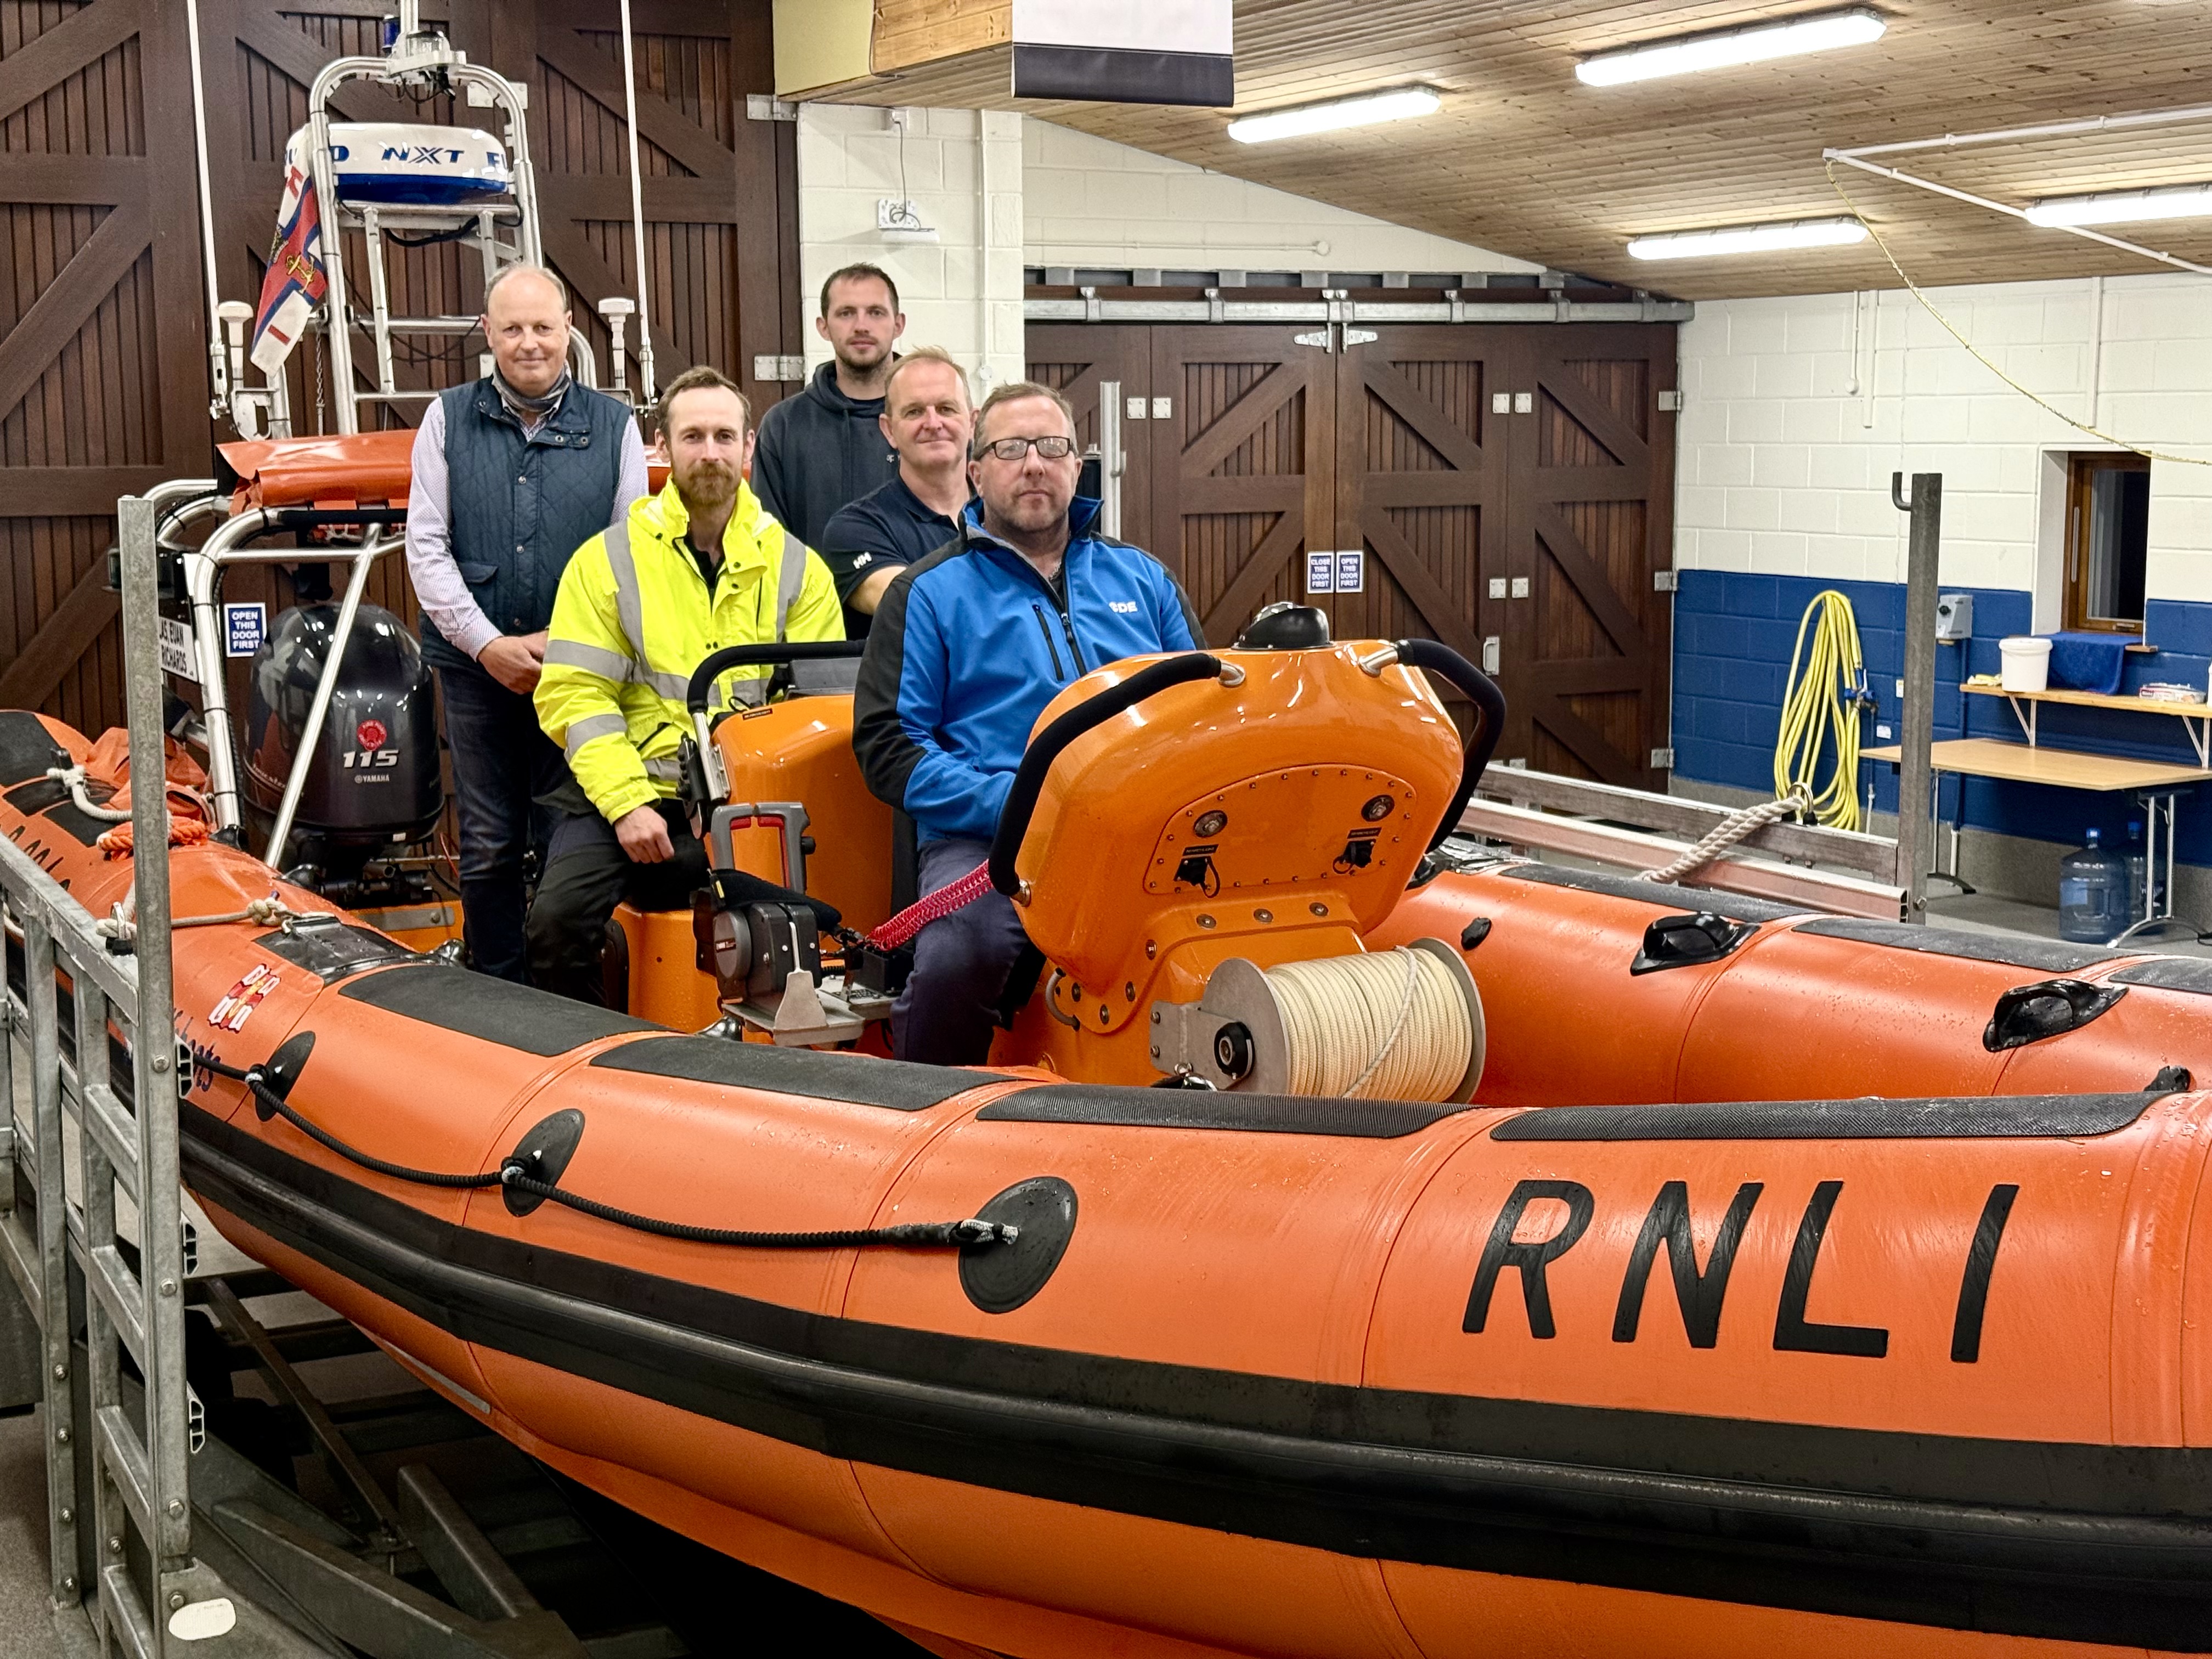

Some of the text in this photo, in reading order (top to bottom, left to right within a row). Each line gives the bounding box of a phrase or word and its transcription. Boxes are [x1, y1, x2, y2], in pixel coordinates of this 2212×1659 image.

[381, 146, 465, 164] NXT
[232, 611, 258, 620] OPEN
[235, 620, 256, 630] THIS
[232, 630, 260, 640] DOOR
[233, 640, 260, 650] FIRST
[343, 749, 399, 769] 115
[363, 774, 390, 783] YAMAHA
[1462, 1179, 2020, 1364] RNLI
